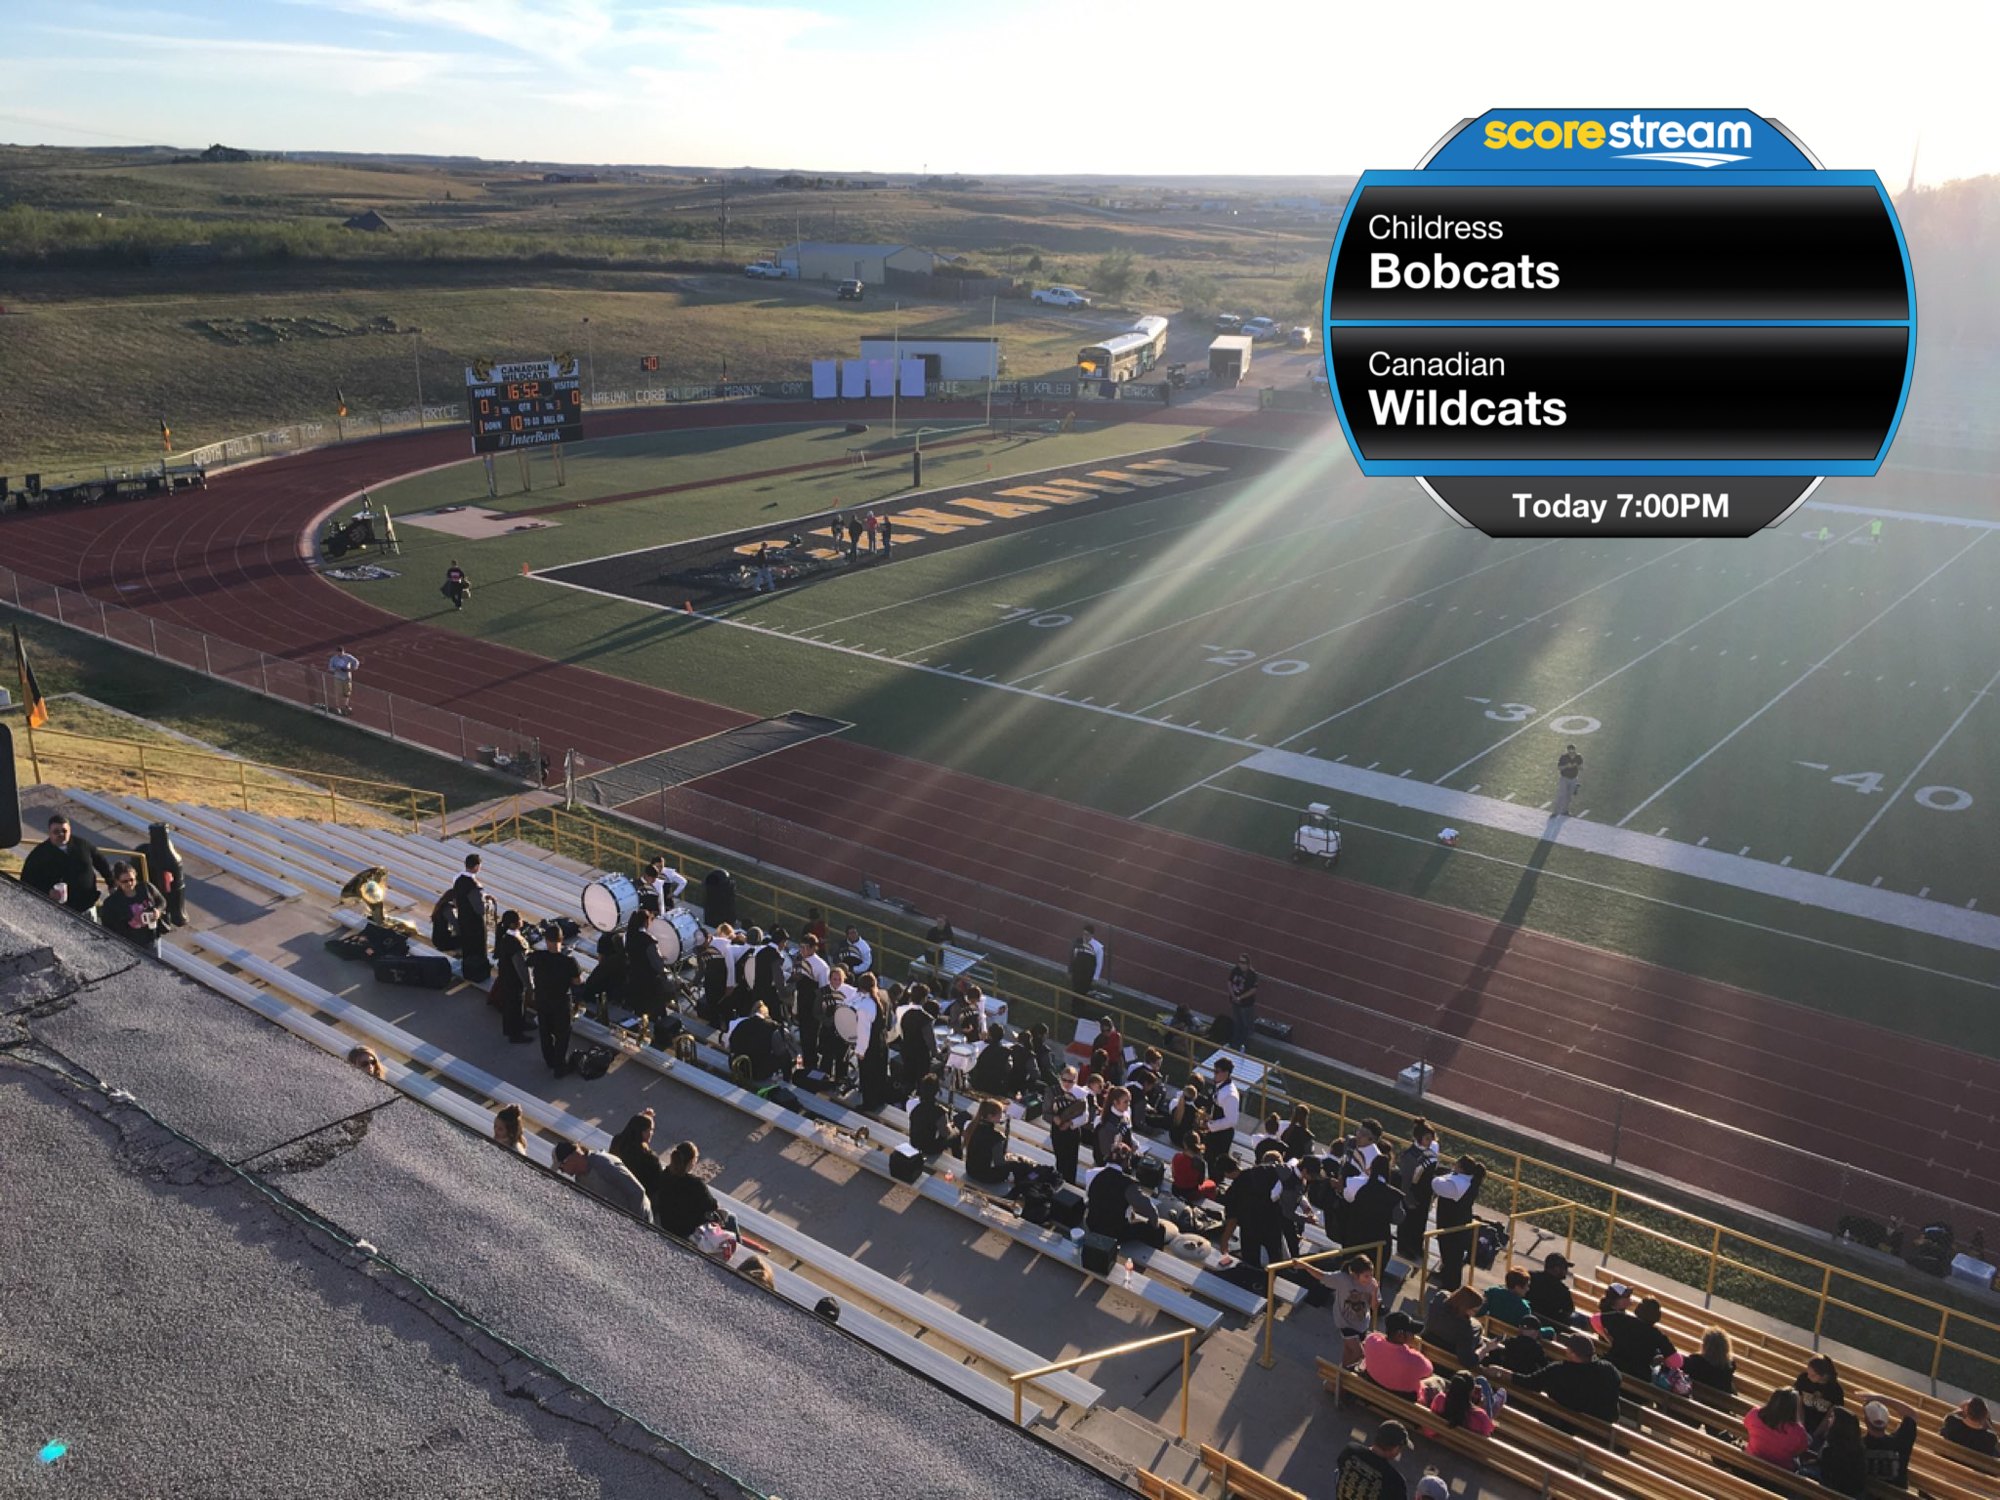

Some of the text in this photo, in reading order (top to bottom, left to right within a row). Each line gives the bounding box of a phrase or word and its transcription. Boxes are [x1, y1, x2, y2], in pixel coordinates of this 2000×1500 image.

[501, 363, 550, 374] CANADIAN
[643, 356, 658, 370] 40
[502, 371, 550, 381] WILDCATS
[475, 387, 497, 398] HOME
[1033, 381, 1071, 395] KALEB
[571, 390, 580, 405] 0
[480, 399, 489, 415] 0
[484, 421, 502, 431] DOWN
[510, 415, 523, 431] 10
[510, 429, 561, 446] InterBank
[1000, 607, 1073, 628] 10
[1202, 648, 1310, 676] 20
[1485, 702, 1602, 735] 30
[1830, 770, 1974, 812] 40
